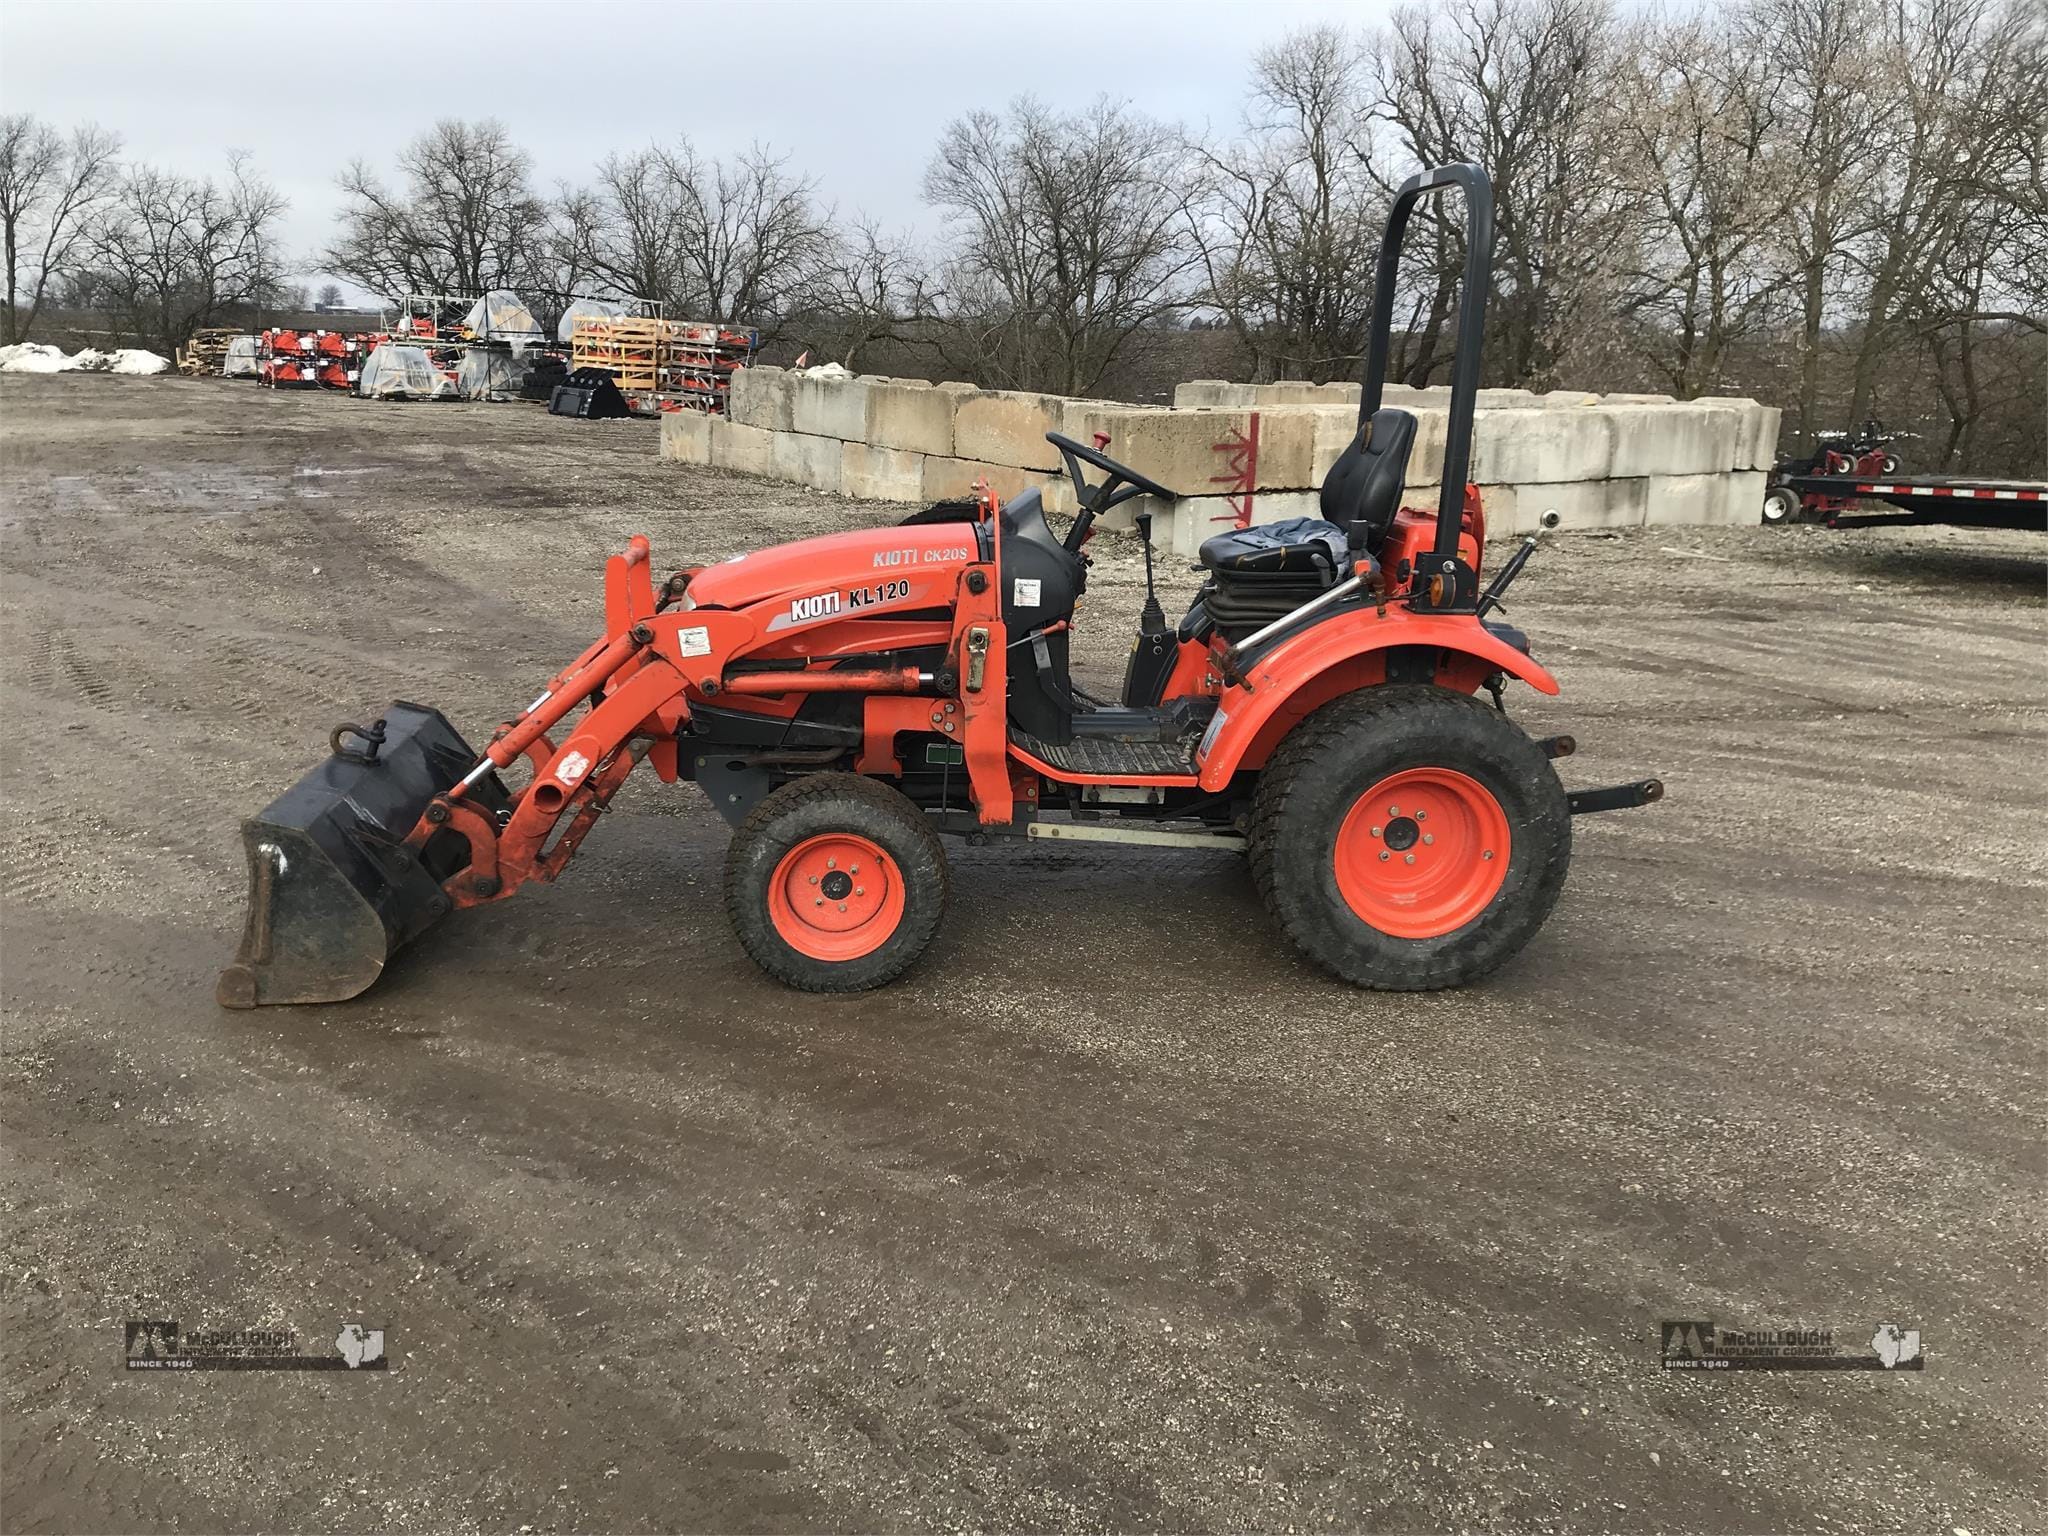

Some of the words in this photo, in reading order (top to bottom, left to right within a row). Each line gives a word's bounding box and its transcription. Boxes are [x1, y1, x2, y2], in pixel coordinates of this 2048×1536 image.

[873, 548, 918, 567] KIOTI
[924, 548, 968, 563] CK20S
[791, 591, 841, 622] KIOTI
[849, 579, 911, 609] KL120
